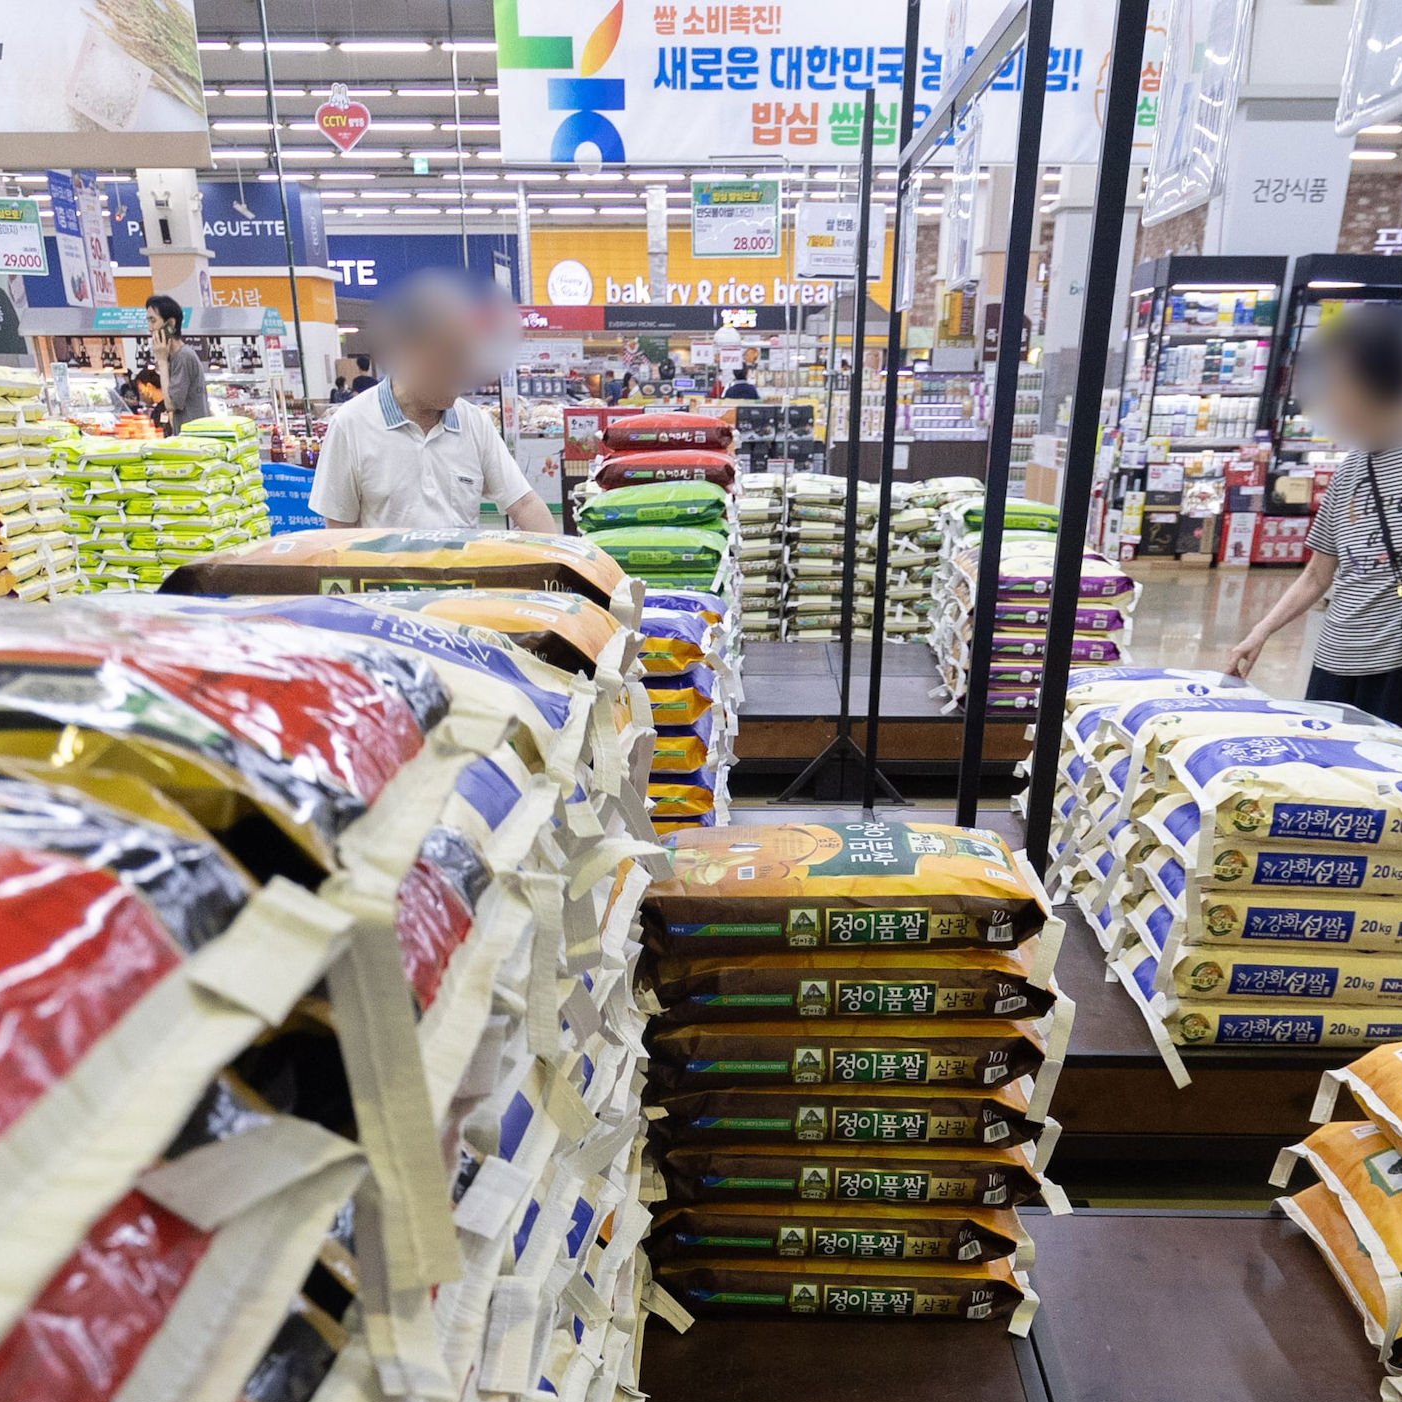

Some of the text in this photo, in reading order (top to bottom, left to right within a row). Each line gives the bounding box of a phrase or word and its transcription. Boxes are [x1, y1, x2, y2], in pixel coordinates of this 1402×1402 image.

[654, 5, 782, 35] 쌀 소비촉진!
[653, 46, 760, 91] 새로운
[770, 46, 905, 91] 대한민국
[323, 116, 346, 127] CCTV
[752, 102, 819, 146] 밥심
[1253, 178, 1328, 203] 건강식품
[734, 237, 773, 251] 28,000
[4, 254, 42, 268] 29,000
[212, 288, 262, 307] 도시락
[606, 276, 691, 305] bakry
[718, 277, 765, 304] rice
[1296, 808, 1376, 837] 강화섬쌀
[846, 822, 890, 867] 정이품쌀
[1279, 858, 1359, 885] 강화섬쌀
[831, 913, 970, 941] 정이품쌀 삼광
[1267, 914, 1347, 941] 강화섬쌀
[1250, 968, 1330, 997] 강화섬쌀
[840, 986, 977, 1012] 정이품쌀 삼광
[1237, 1018, 1316, 1045] 강화섬쌀
[834, 1053, 968, 1079] 정이품쌀 삼광
[837, 1112, 968, 1138] 정이품쌀 삼광
[840, 1173, 968, 1197] 정이품쌀 삼광
[817, 1232, 943, 1257] 정이품쌀 삼광
[828, 1290, 952, 1313] 정이품쌀 삼광
